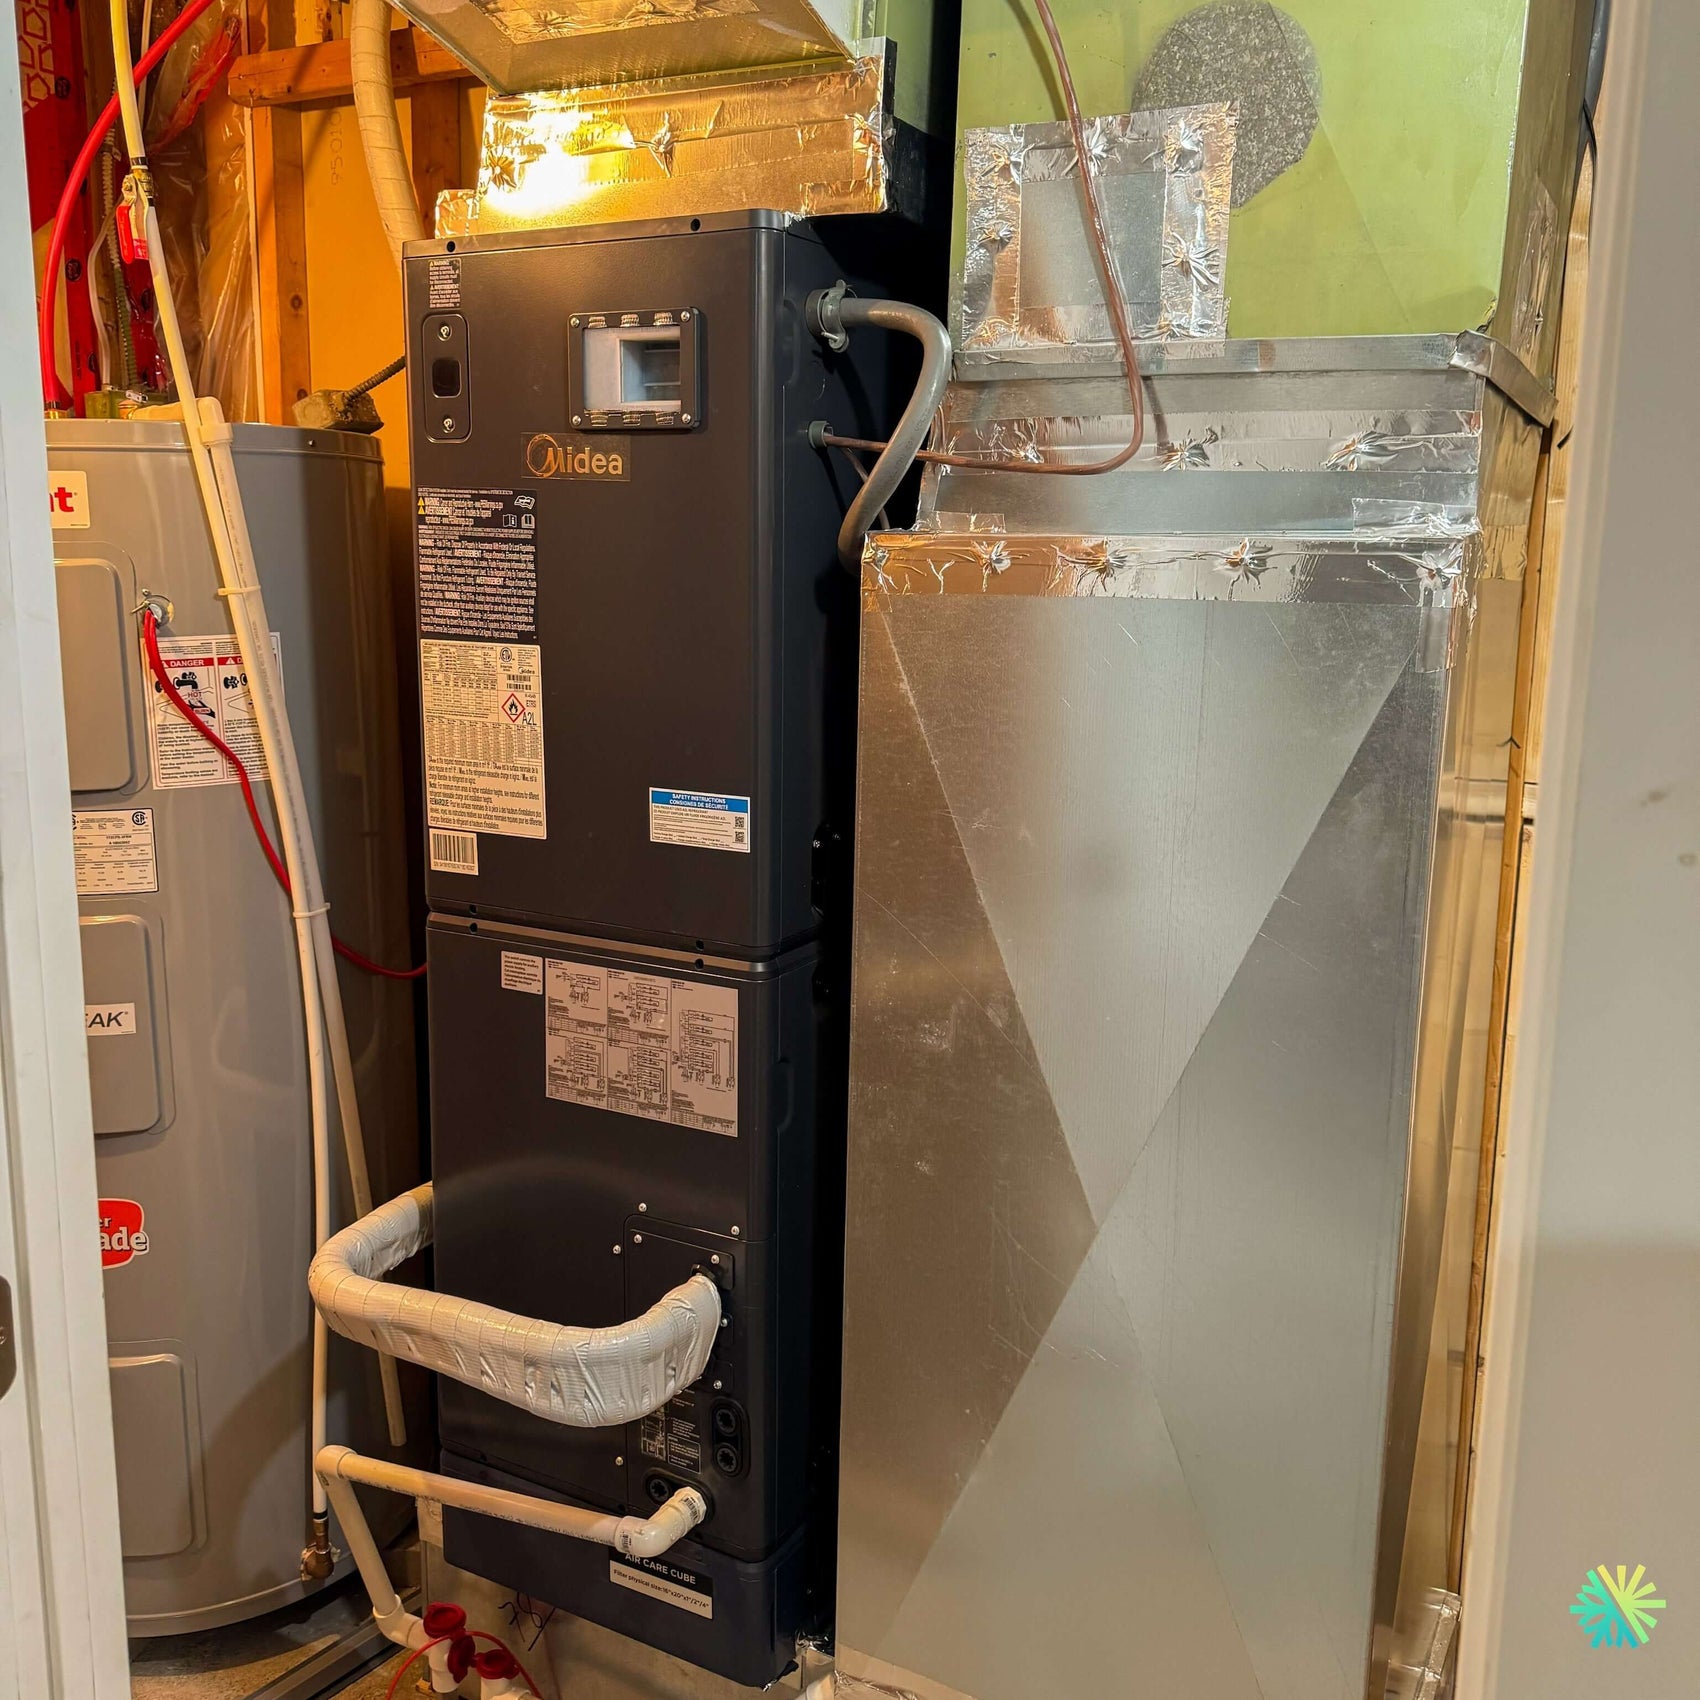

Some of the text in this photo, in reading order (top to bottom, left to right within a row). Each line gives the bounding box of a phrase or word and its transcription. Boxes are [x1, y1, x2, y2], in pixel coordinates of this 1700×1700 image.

[526, 434, 623, 478] Midea
[522, 712, 537, 726] A2L
[691, 796, 726, 804] INSTRUCTIONS
[625, 1553, 696, 1584] AIR CARE CUBE
[614, 1569, 628, 1578] Filter
[628, 1573, 650, 1588] physical
